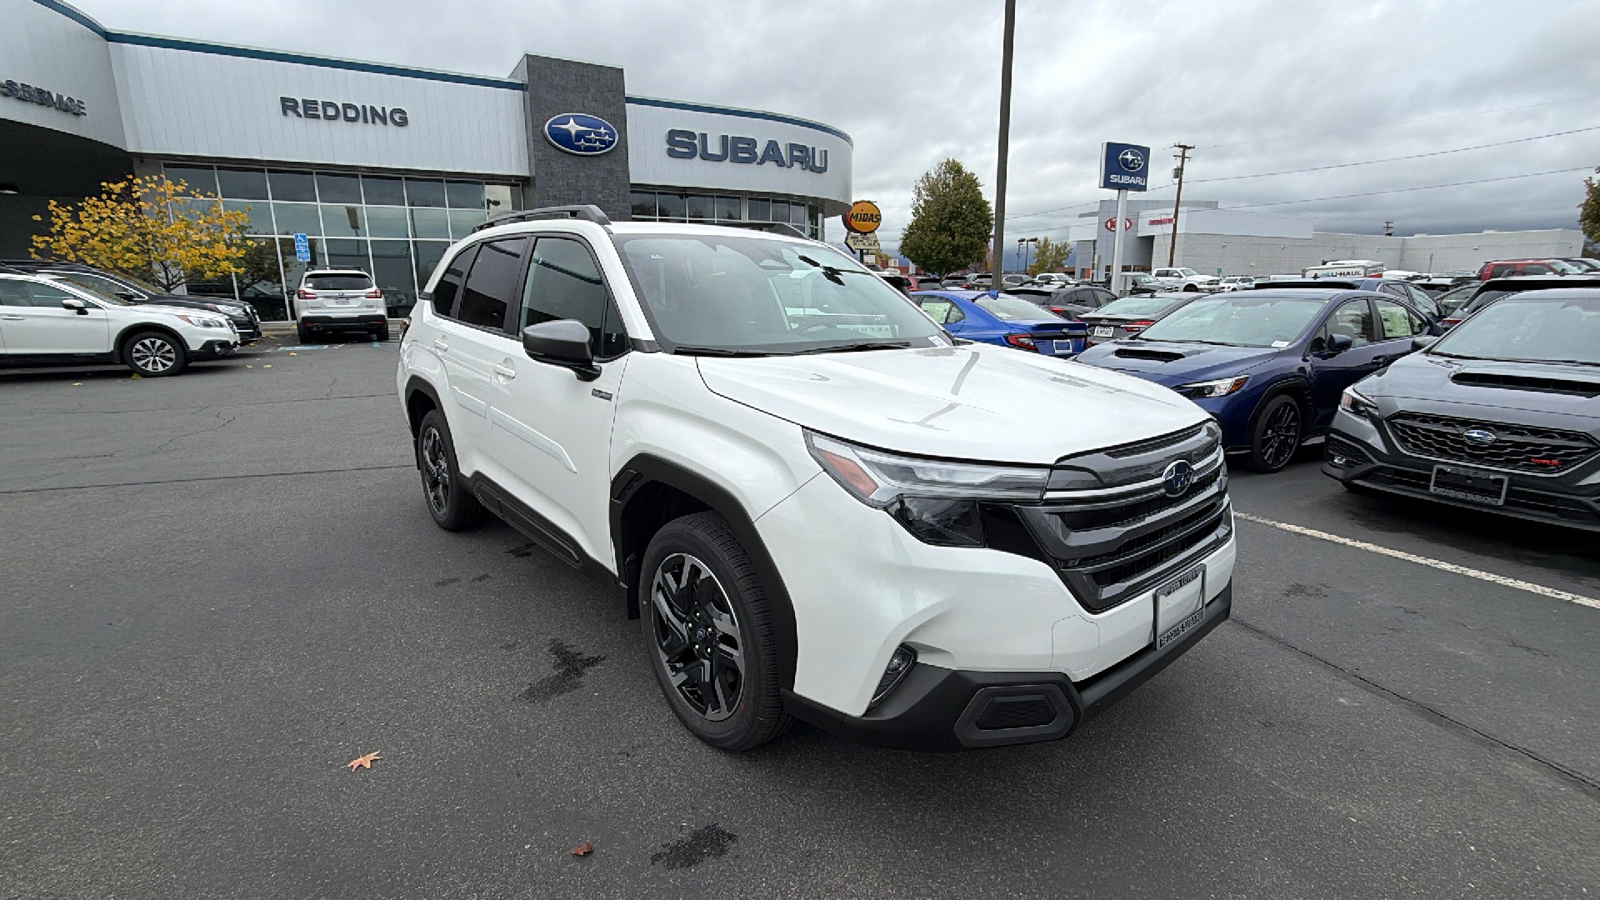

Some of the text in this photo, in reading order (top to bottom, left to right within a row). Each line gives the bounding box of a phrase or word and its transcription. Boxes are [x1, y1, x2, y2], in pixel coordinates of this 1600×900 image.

[2, 79, 87, 116] SERVICE
[280, 96, 409, 127] REDDING
[666, 128, 828, 174] SUBARU
[1109, 174, 1146, 186] SUBARU
[850, 213, 881, 223] MIDAS
